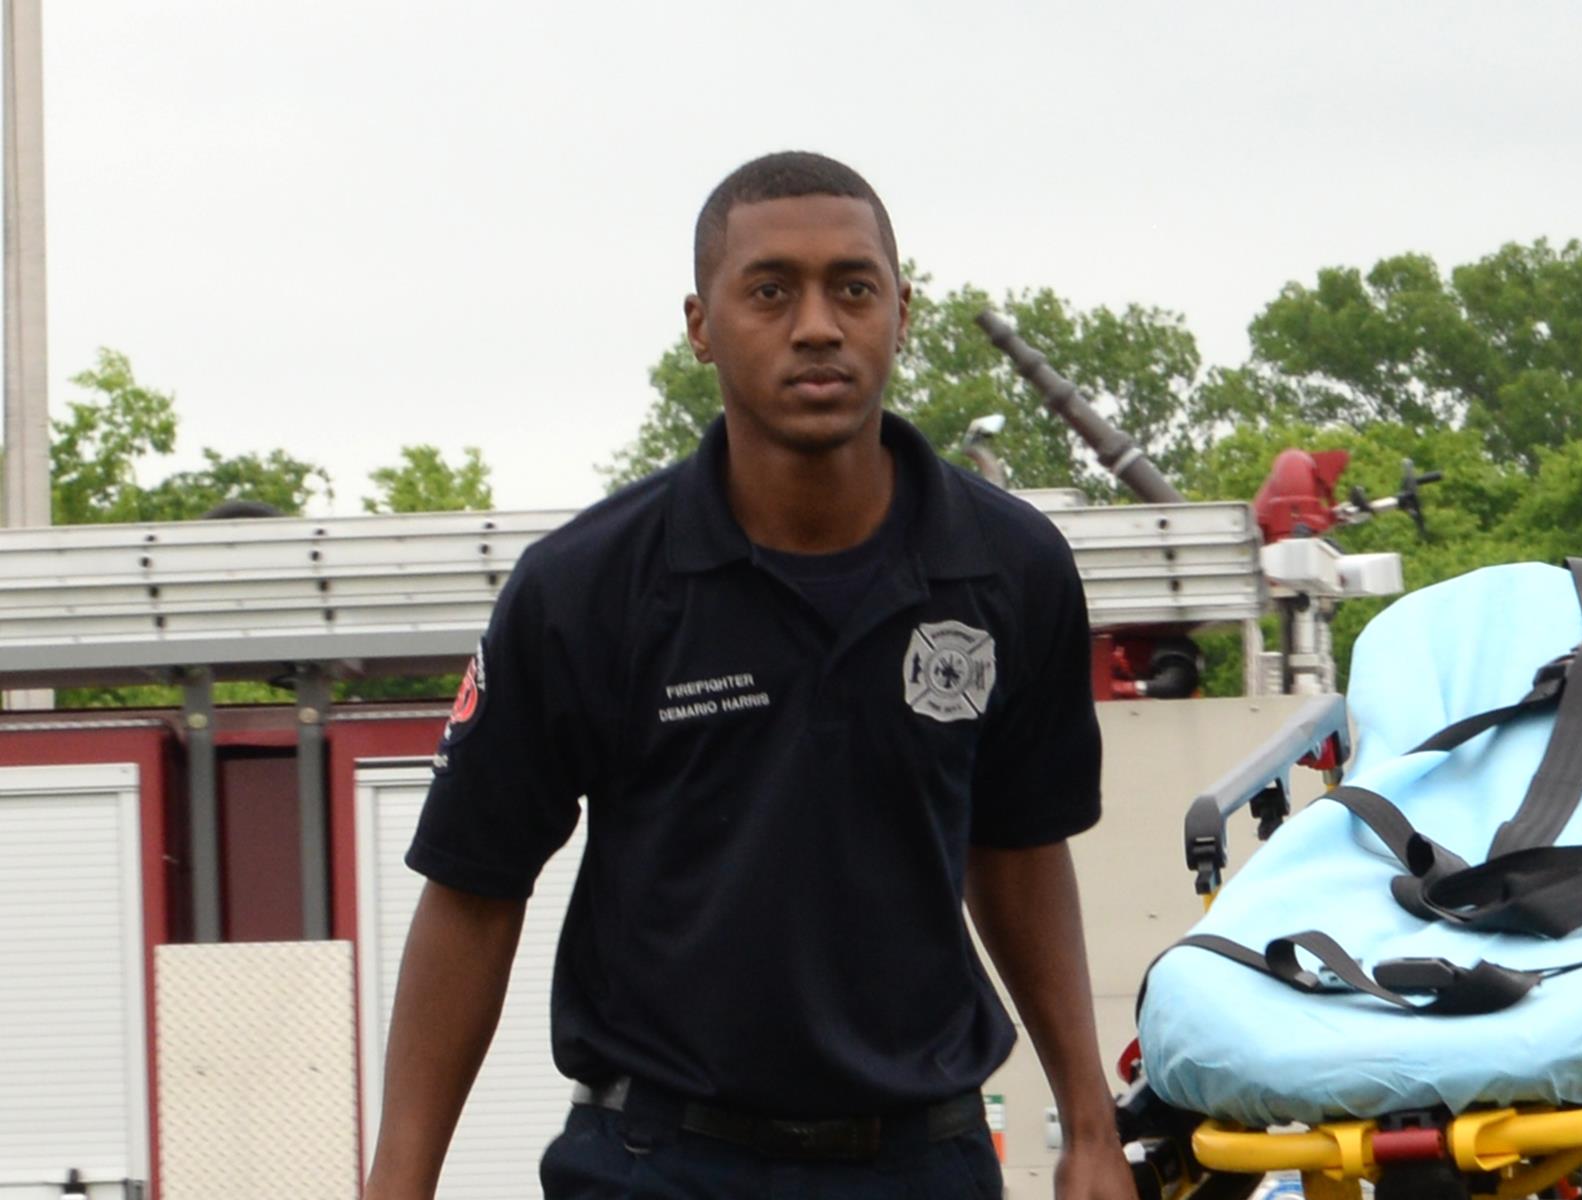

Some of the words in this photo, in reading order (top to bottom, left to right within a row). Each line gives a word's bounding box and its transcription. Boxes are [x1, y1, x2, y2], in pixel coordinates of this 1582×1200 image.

[665, 673, 755, 699] FIREFIGHTER
[659, 700, 718, 722] DEMARIO
[721, 692, 770, 712] HARRIS
